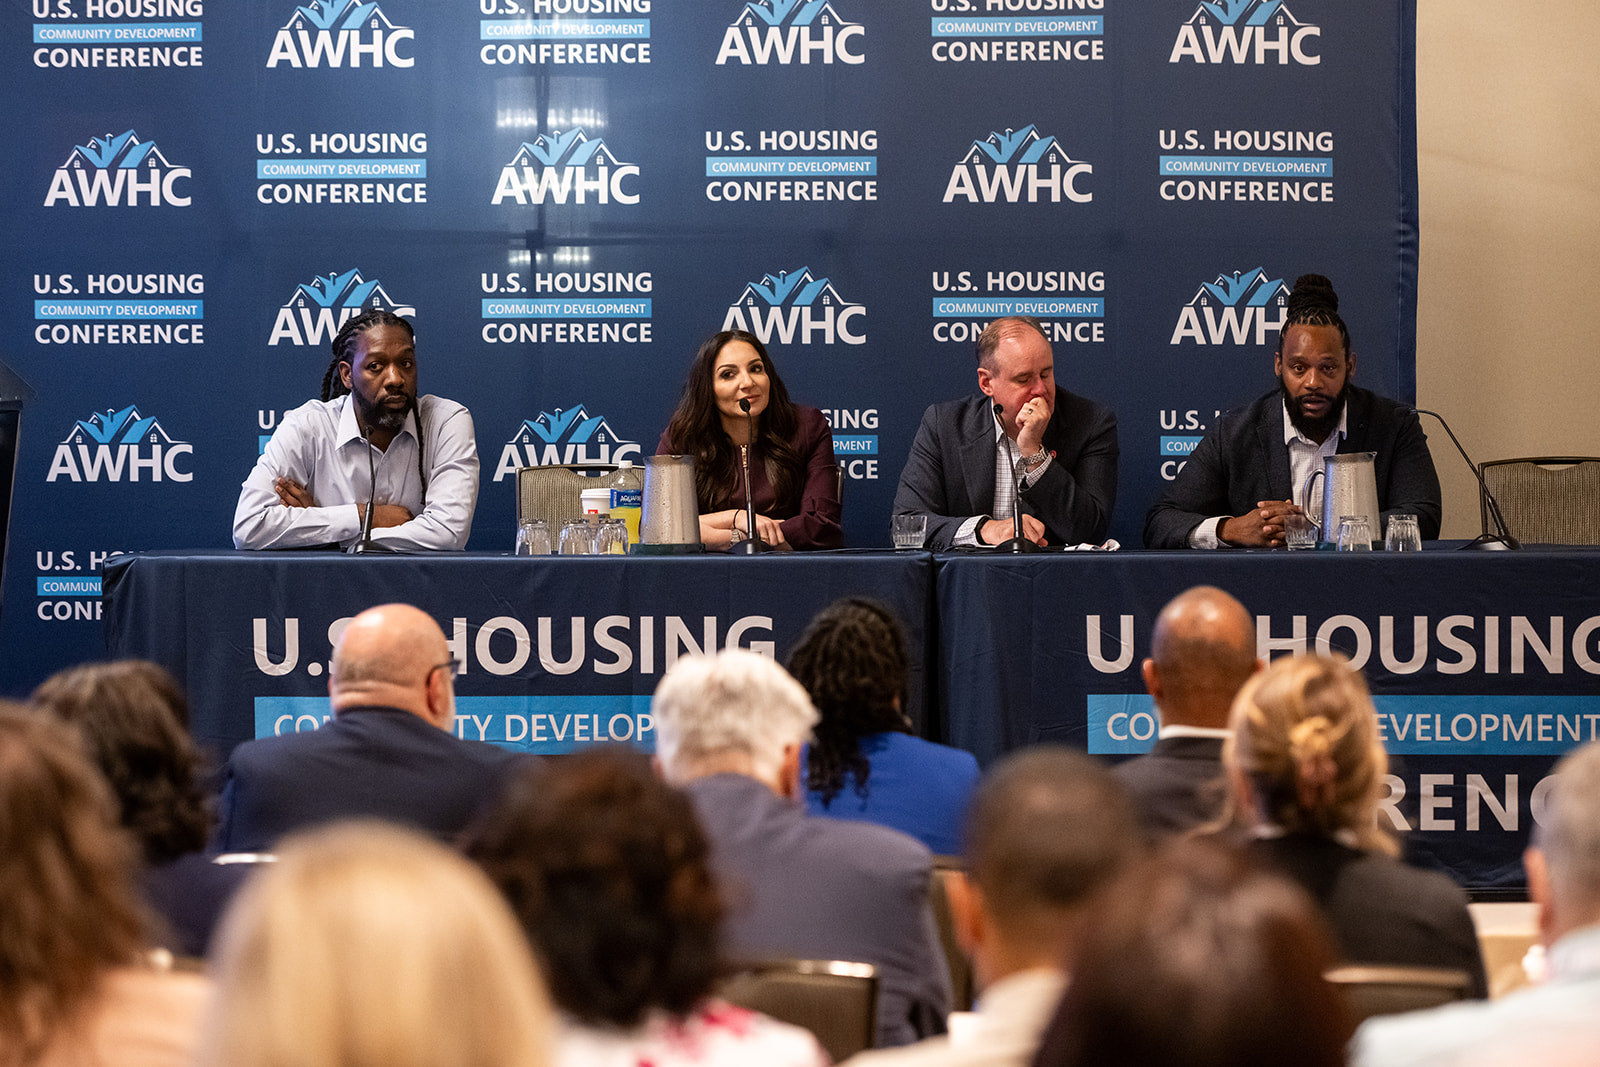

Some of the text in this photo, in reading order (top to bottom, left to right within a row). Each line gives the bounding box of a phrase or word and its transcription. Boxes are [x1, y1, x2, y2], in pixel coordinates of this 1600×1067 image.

[32, 0, 203, 19] U.S. HOUSING
[479, 0, 651, 15] U.S. HOUSING
[39, 27, 197, 40] COMMUNITY DEVELOPMENT
[486, 24, 645, 36] COMMUNITY DEVELOPMENT
[937, 20, 1098, 33] COMMUNITY DEVELOPMENT
[266, 28, 415, 68] AWHC
[480, 43, 651, 65] CONFERENCE
[715, 25, 865, 65] AWHC
[931, 40, 1104, 62] CONFERENCE
[1168, 26, 1321, 66] AWHC
[33, 46, 203, 68] CONFERENCE
[256, 132, 428, 154] U.S. HOUSING
[705, 129, 878, 152] U.S. HOUSING
[1159, 129, 1334, 152] U.S. HOUSING
[262, 163, 421, 175] COMMUNITY DEVELOPMENT
[711, 161, 872, 173] COMMUNITY DEVELOPMENT
[1165, 160, 1327, 173] COMMUNITY DEVELOPMENT
[44, 166, 192, 207] AWHC
[256, 182, 427, 204] CONFERENCE
[491, 165, 640, 205] AWHC
[705, 180, 878, 202] CONFERENCE
[942, 163, 1093, 203] AWHC
[1159, 180, 1334, 202] CONFERENCE
[34, 273, 204, 295] U.S. HOUSING
[481, 272, 653, 293] U.S. HOUSING
[932, 271, 1105, 292] U.S. HOUSING
[40, 304, 198, 316] COMMUNITY DEVELOPMENT
[487, 303, 646, 315] COMMUNITY DEVELOPMENT
[938, 302, 1099, 314] COMMUNITY DEVELOPMENT
[34, 324, 204, 344] CONFERENCE
[481, 322, 653, 344] CONFERENCE
[1159, 409, 1206, 431] U.S.
[45, 443, 194, 483] AWHC
[36, 550, 82, 571] U.S.
